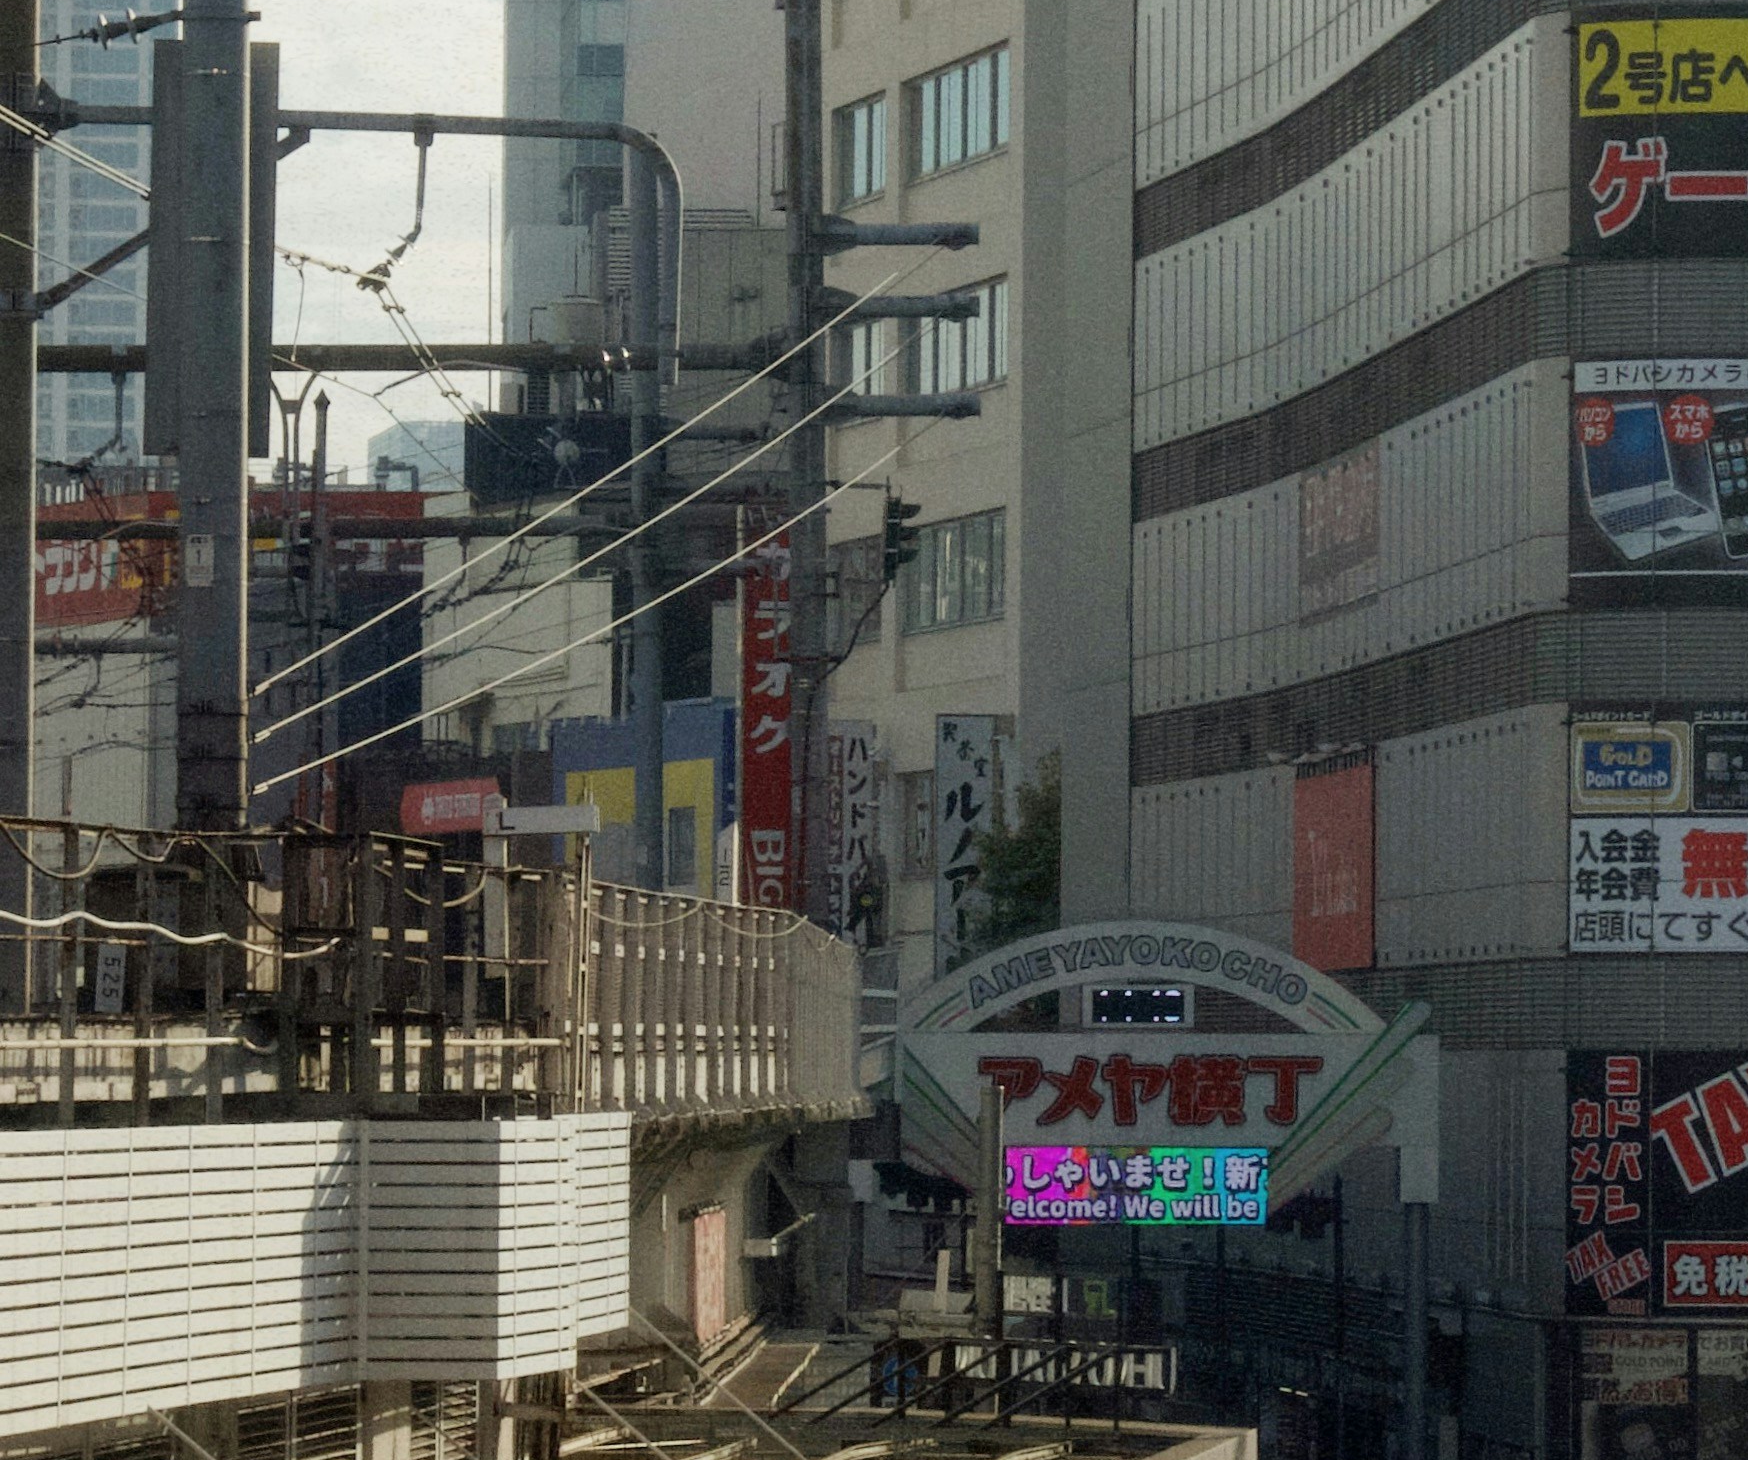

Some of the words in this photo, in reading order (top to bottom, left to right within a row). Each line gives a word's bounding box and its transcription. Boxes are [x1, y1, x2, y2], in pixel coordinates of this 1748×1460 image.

[1668, 403, 1711, 421] スマホ
[1674, 421, 1705, 441] から
[1575, 828, 1662, 864] 入会金
[1575, 867, 1662, 903] 年会費
[968, 934, 1309, 1011] AMEYAYOKOCHO
[976, 1053, 1325, 1128] アメヤ横丁
[1570, 1098, 1600, 1225] カメラ
[1602, 1055, 1642, 1225] ヨドバシ
[1006, 1154, 1268, 1193] しゃいませ！新
[1006, 1195, 1116, 1220] elcome!
[1124, 1195, 1167, 1220] We
[1171, 1194, 1221, 1220] will
[1226, 1195, 1259, 1220] be
[1564, 1230, 1615, 1285] TAX
[1594, 1248, 1651, 1302] FREE
